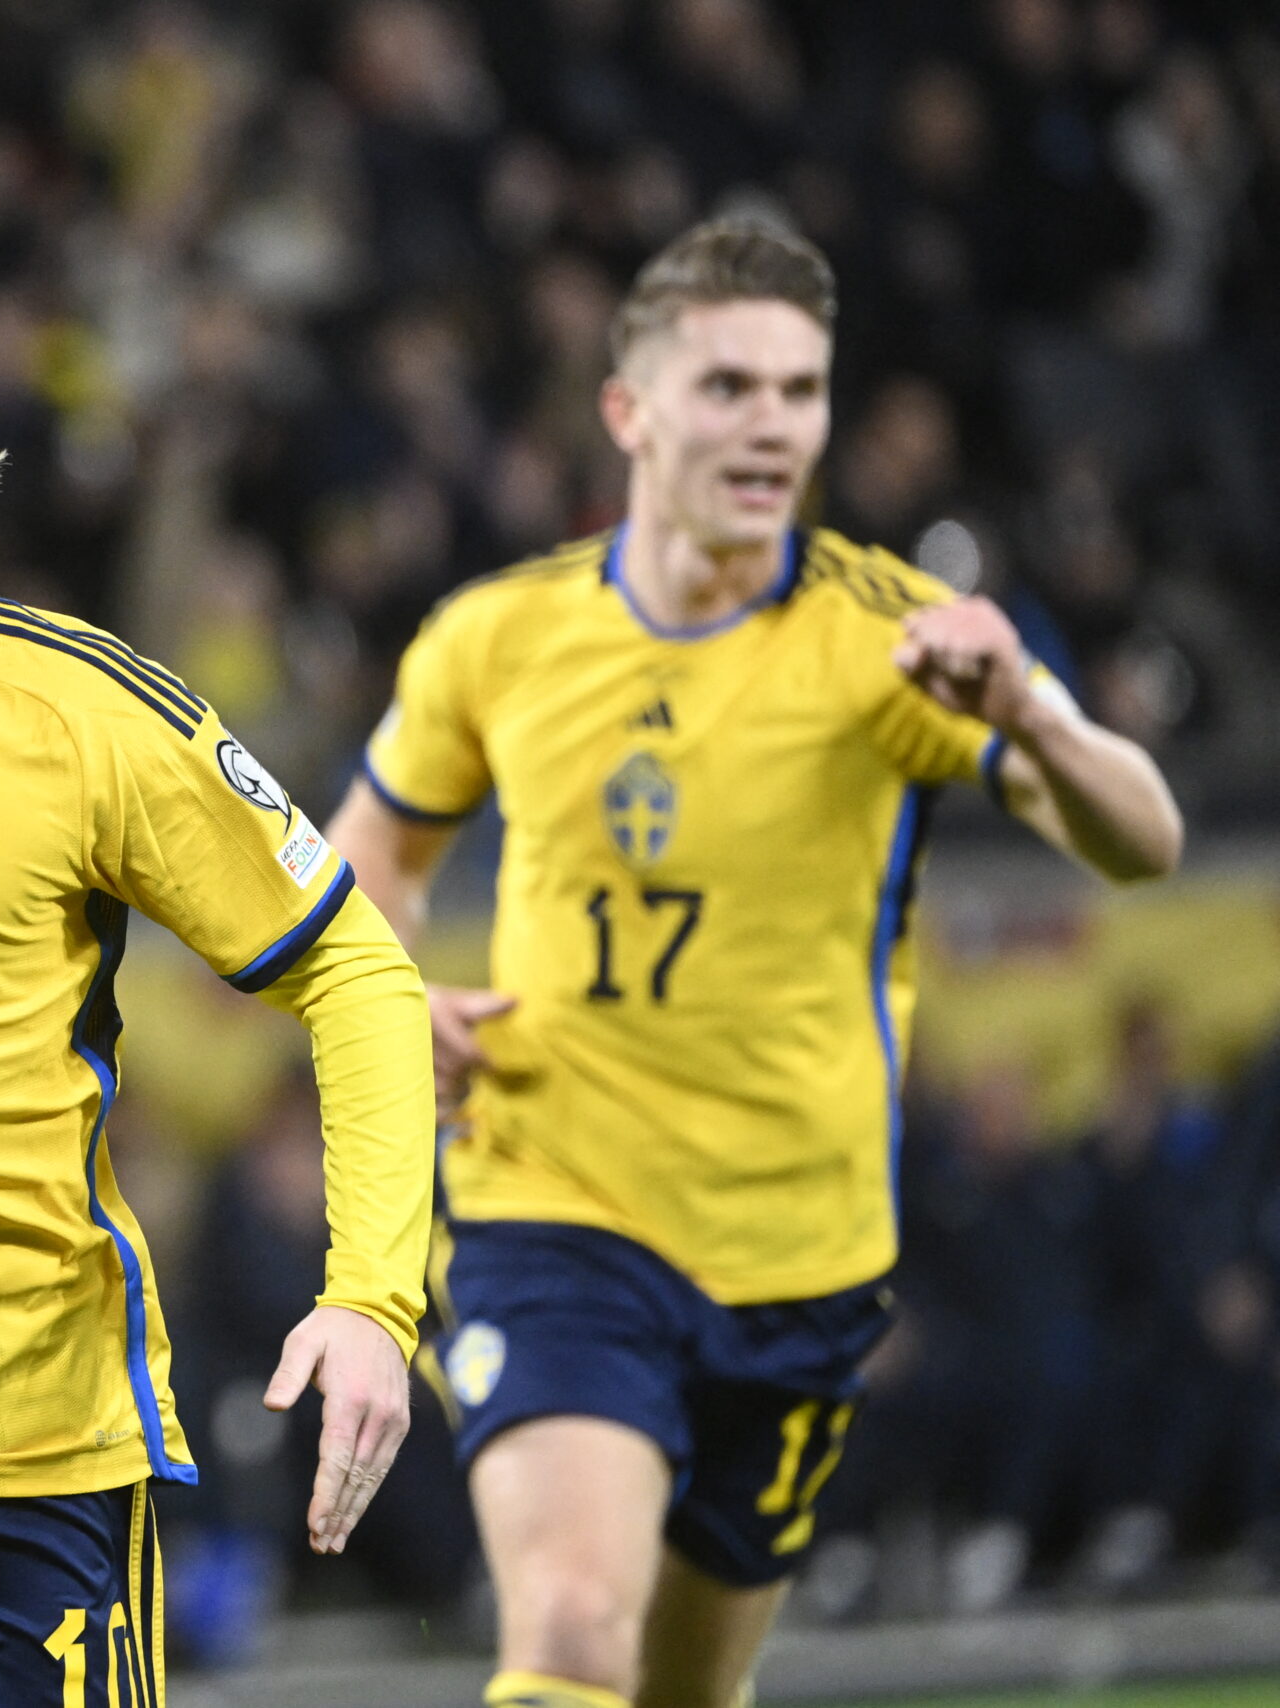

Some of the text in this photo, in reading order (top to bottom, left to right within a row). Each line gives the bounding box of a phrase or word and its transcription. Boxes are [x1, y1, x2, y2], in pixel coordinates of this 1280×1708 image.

[280, 839, 299, 863] UEFA
[287, 829, 320, 876] FOUN
[587, 887, 704, 1005] 17
[42, 1601, 139, 1708] 10
